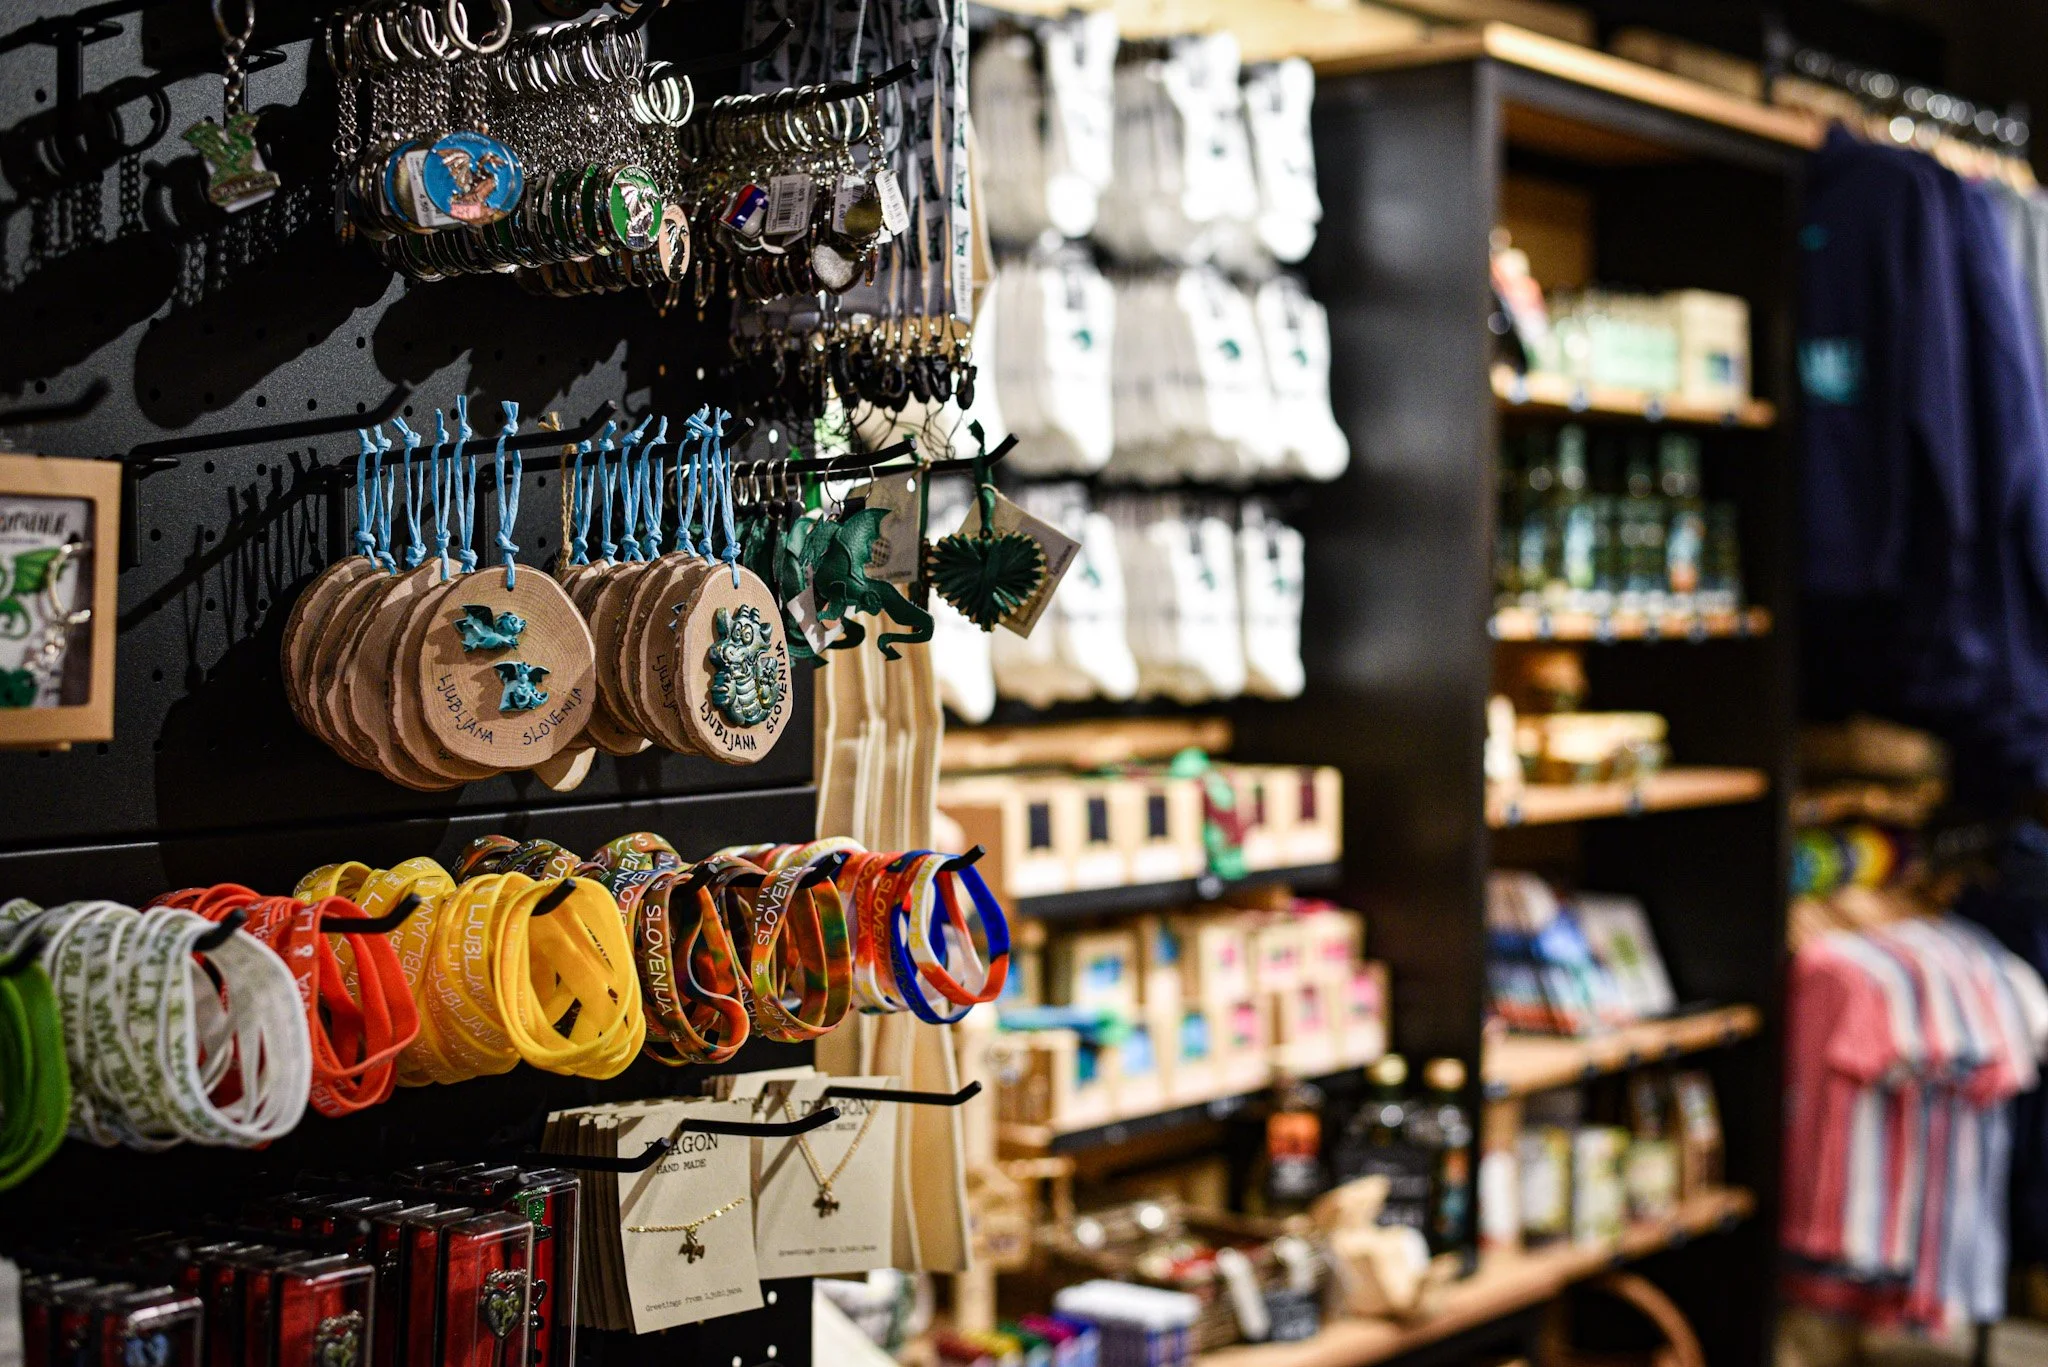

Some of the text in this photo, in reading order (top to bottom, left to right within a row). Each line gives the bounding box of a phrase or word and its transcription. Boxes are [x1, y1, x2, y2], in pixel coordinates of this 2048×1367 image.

[437, 673, 493, 745] LJUBLJANA
[523, 687, 582, 746] SLOVENIJA
[766, 640, 788, 735] SLOVENIJA
[700, 701, 757, 752] LJUBLJANA
[645, 904, 673, 1016] SLOVENIJA
[683, 1158, 707, 1171] MADE
